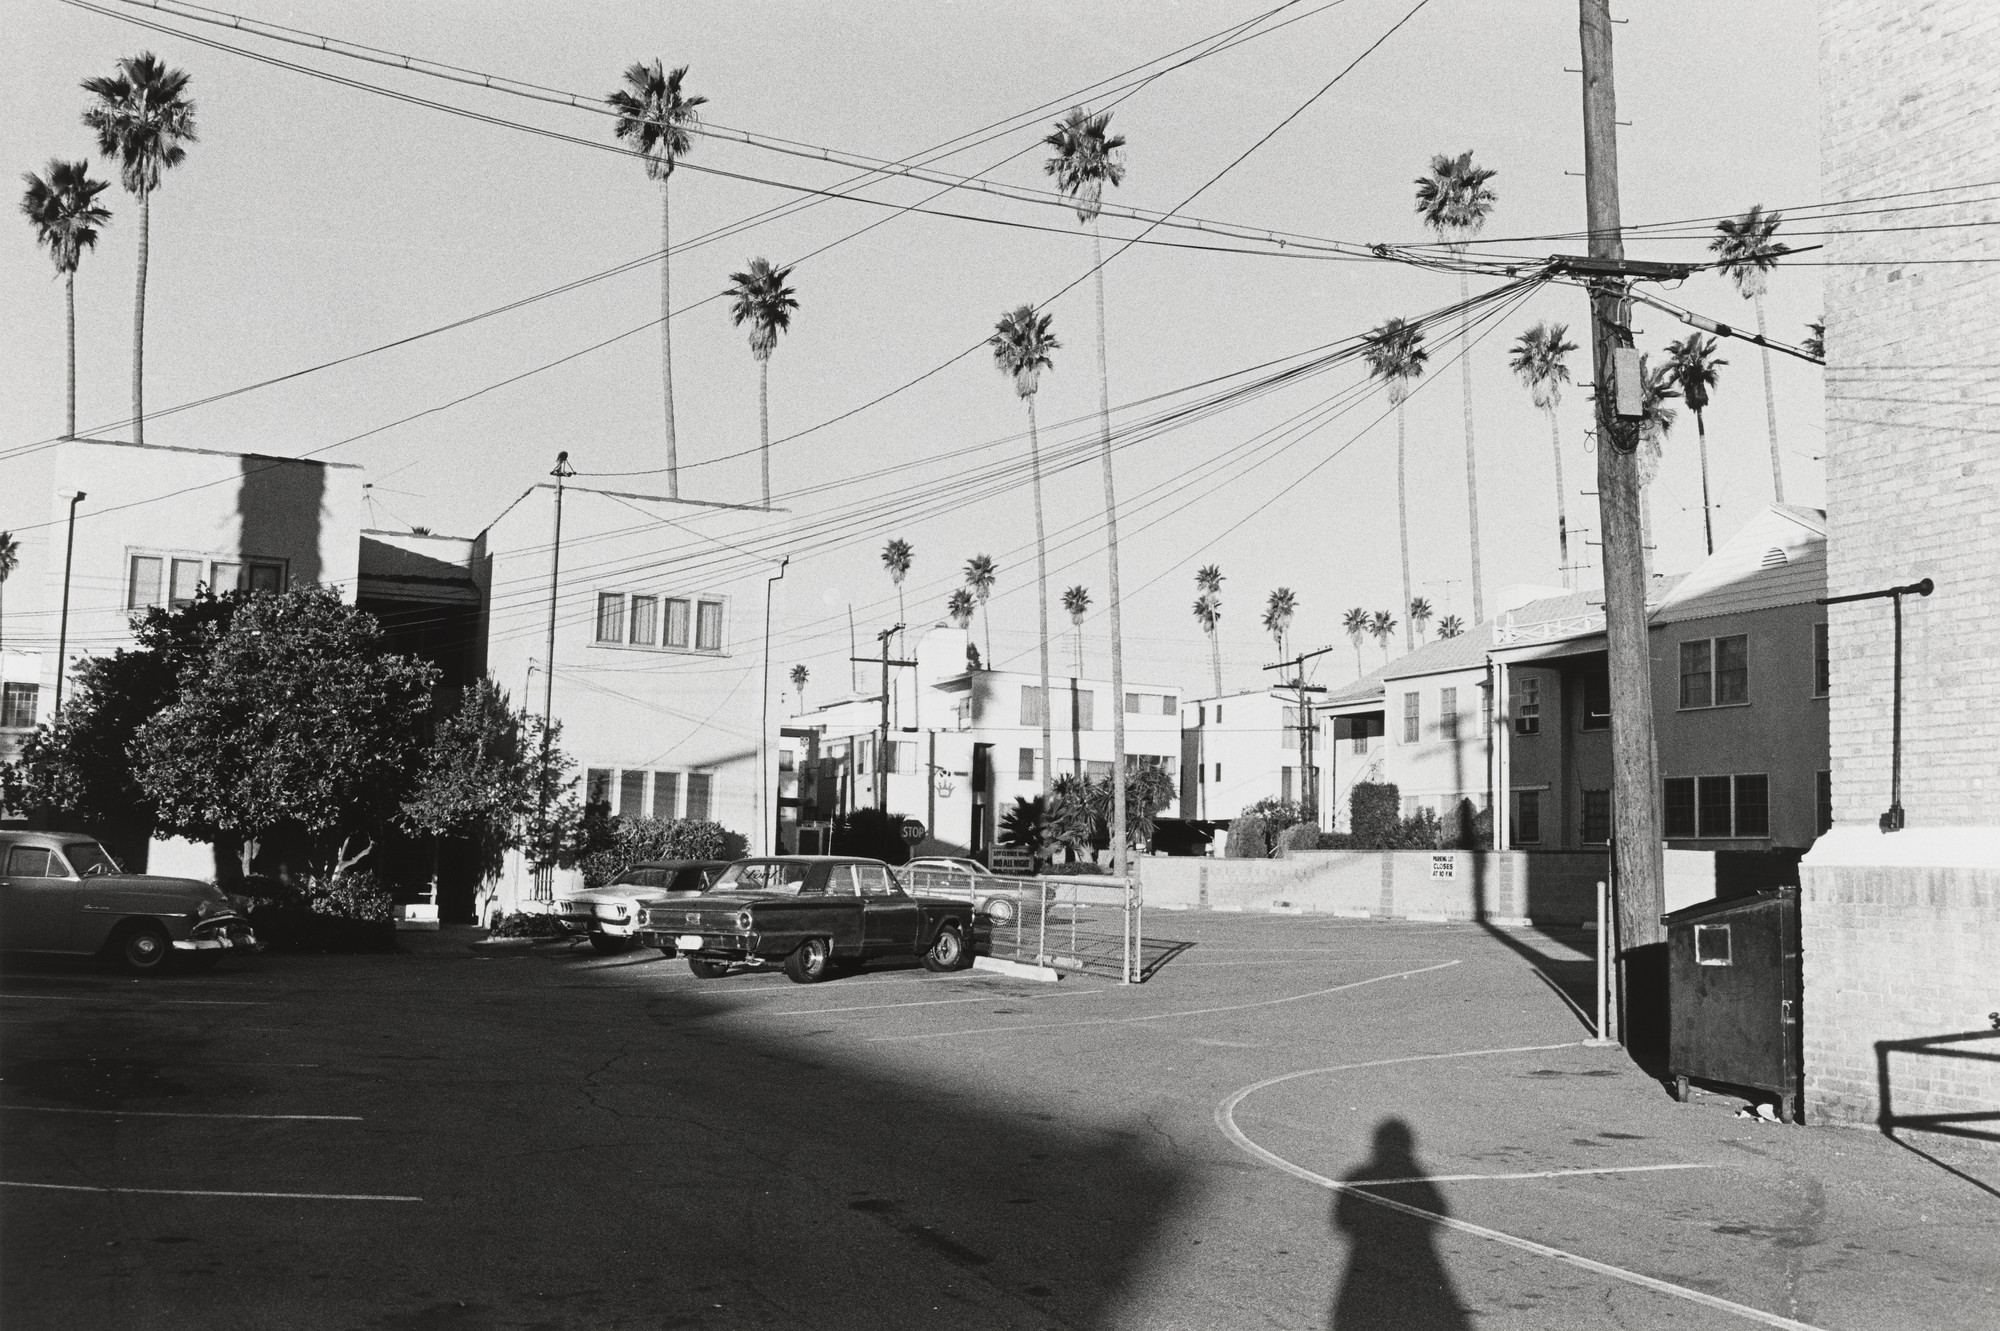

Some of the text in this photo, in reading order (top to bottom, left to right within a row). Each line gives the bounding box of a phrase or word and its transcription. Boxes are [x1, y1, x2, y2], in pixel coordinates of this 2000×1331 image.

[903, 826, 924, 838] STOP
[993, 859, 1003, 867] NO
[1003, 859, 1013, 867] ALL
[746, 870, 778, 879] Ford
